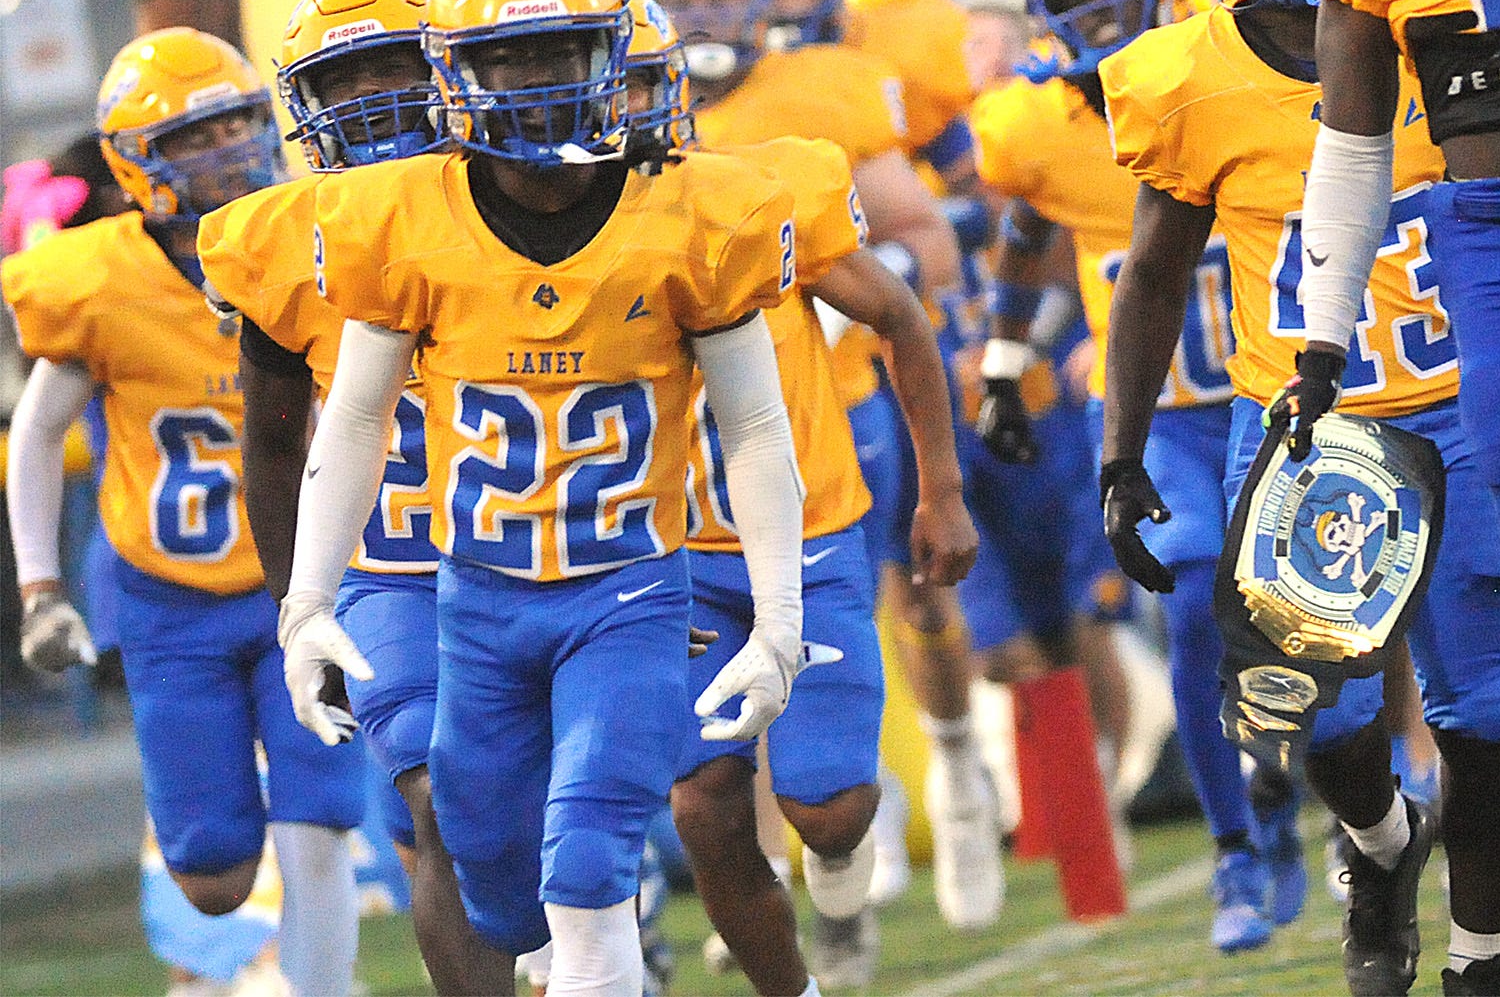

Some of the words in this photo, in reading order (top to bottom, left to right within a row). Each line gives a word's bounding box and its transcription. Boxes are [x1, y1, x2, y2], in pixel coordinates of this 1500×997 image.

[507, 2, 558, 16] Riddell
[327, 22, 375, 41] Riddell
[507, 351, 584, 374] LANEY
[149, 407, 240, 562] 6
[444, 378, 666, 580] 22
[1257, 471, 1293, 535] TURNOVER
[1395, 530, 1418, 569] TOWN
